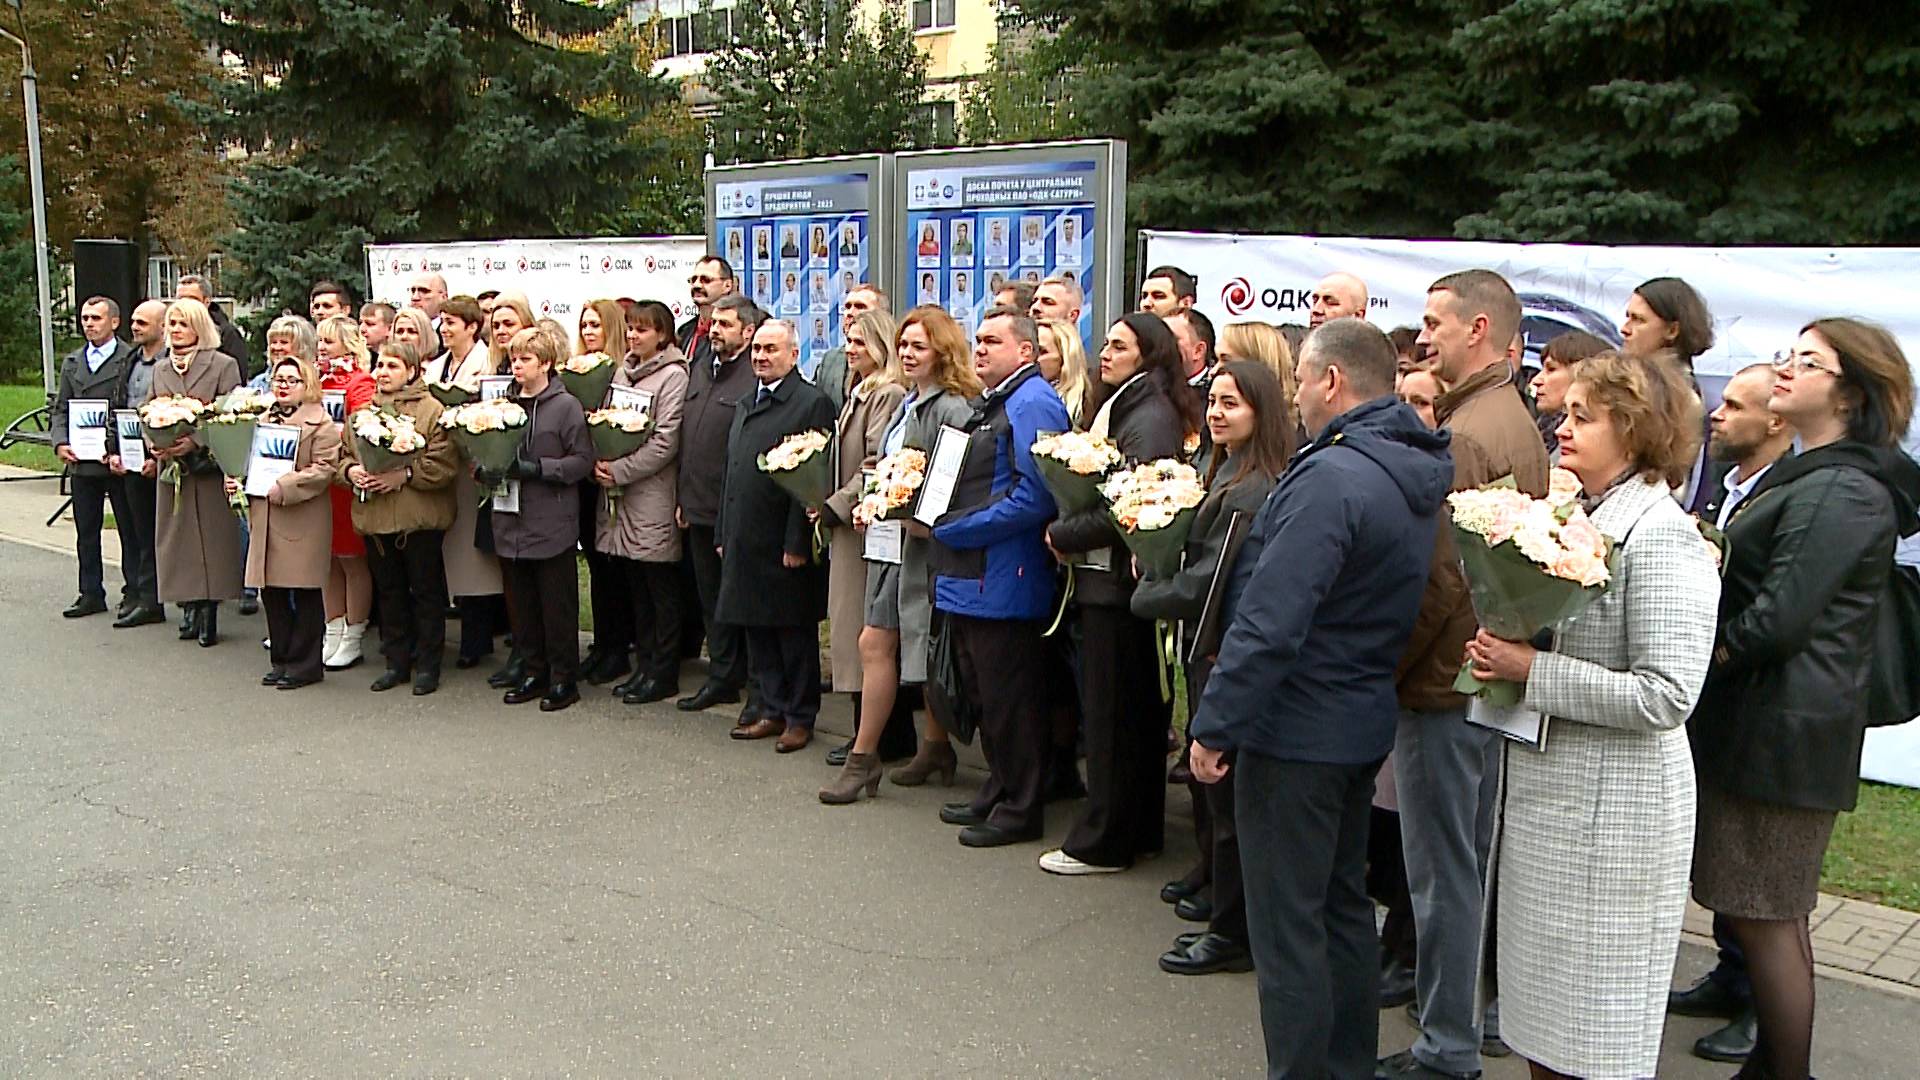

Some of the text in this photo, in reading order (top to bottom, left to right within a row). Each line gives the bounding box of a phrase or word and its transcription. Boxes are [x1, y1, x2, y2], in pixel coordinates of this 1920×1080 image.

[966, 182, 990, 192] ДОСКА
[1026, 177, 1083, 189] ЦЕНТРАЛЬНЫХ
[765, 191, 812, 201] ЛУЧШИЕ ЛЮДИ
[966, 191, 1011, 202] ПРОХОДНЫХ
[1012, 191, 1028, 200] ПАО
[765, 201, 810, 211] ПРЕДПРИЯТИЯ
[615, 259, 633, 270] ОДК
[657, 259, 677, 270] ОДК
[1261, 288, 1313, 312] ОДК
[553, 303, 571, 314] ОДК
